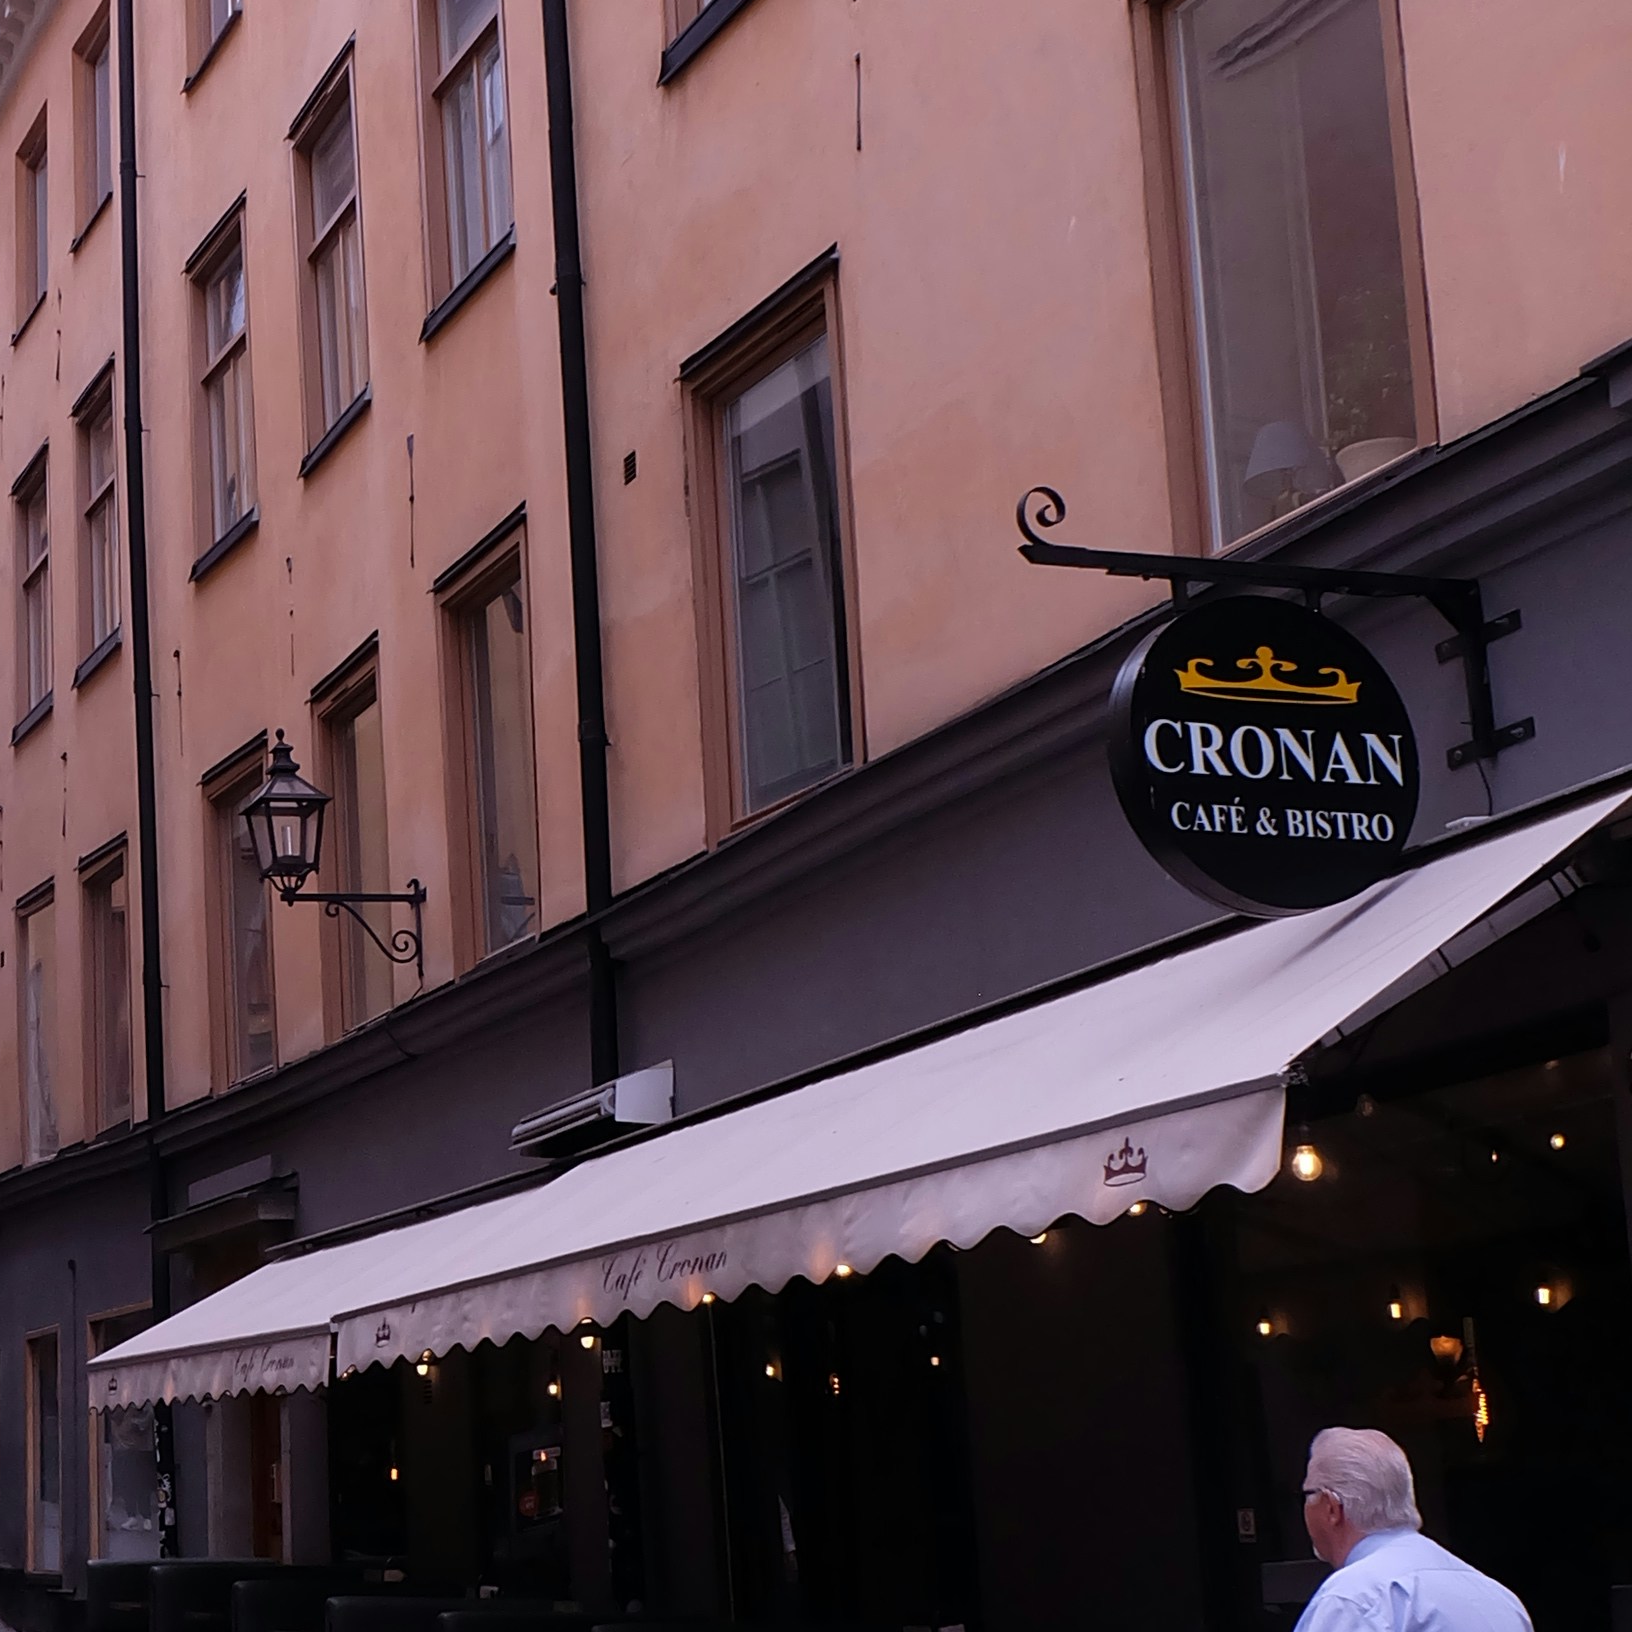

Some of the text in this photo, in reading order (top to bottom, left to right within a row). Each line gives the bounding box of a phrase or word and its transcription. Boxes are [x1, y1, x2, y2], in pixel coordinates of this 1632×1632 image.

[1143, 718, 1405, 787] CRONAN
[1171, 796, 1395, 843] CAFÉ & BISTRO
[656, 1241, 727, 1283] Cronan
